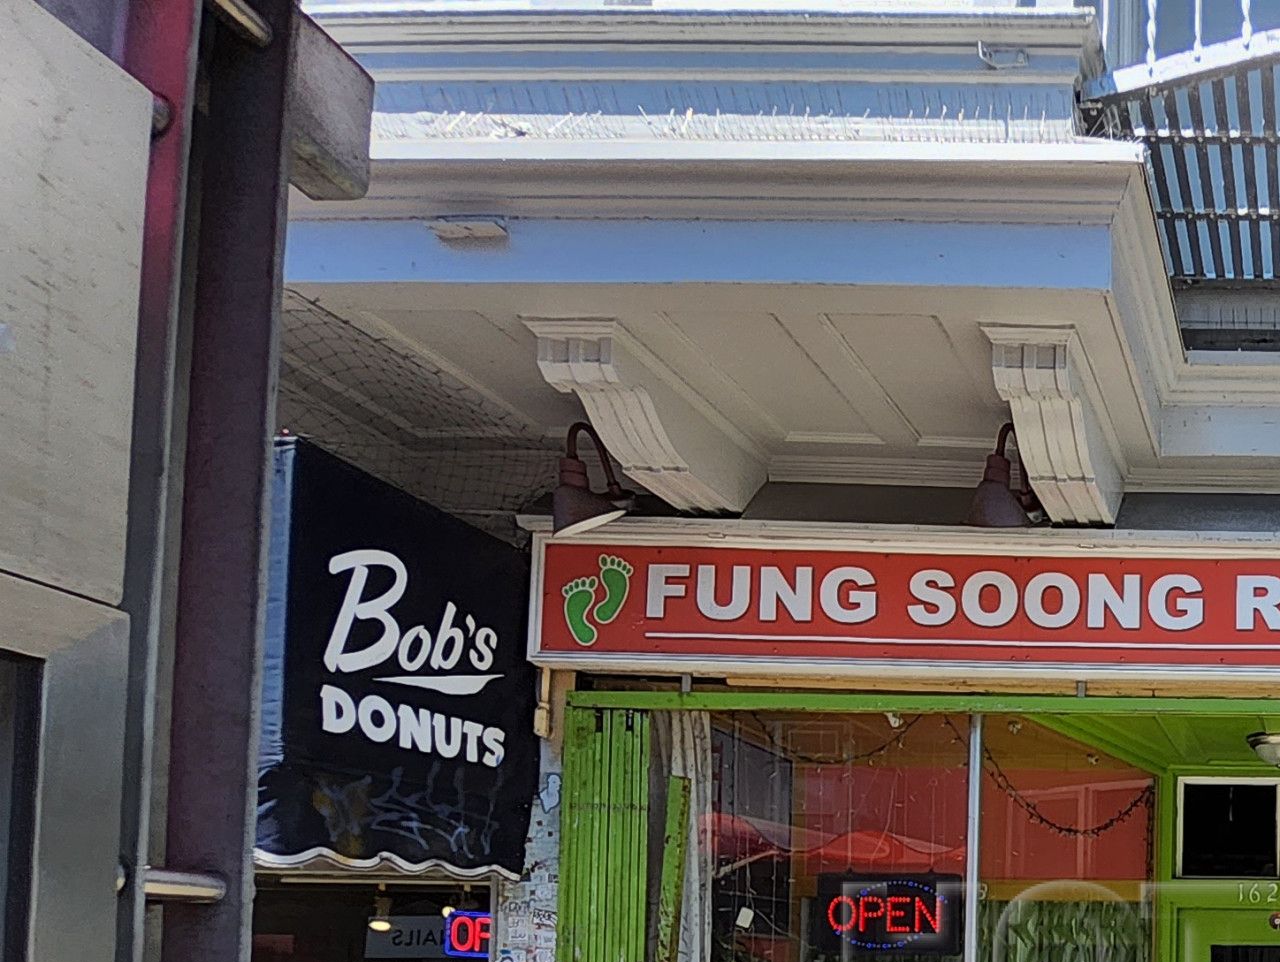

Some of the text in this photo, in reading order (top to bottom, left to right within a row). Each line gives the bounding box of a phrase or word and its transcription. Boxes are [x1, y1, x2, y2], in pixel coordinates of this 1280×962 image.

[323, 549, 498, 673] Bob's
[645, 563, 877, 624] FUNG
[907, 569, 1204, 630] SOONG
[320, 684, 506, 768] DONUTS
[827, 895, 941, 933] OPEN
